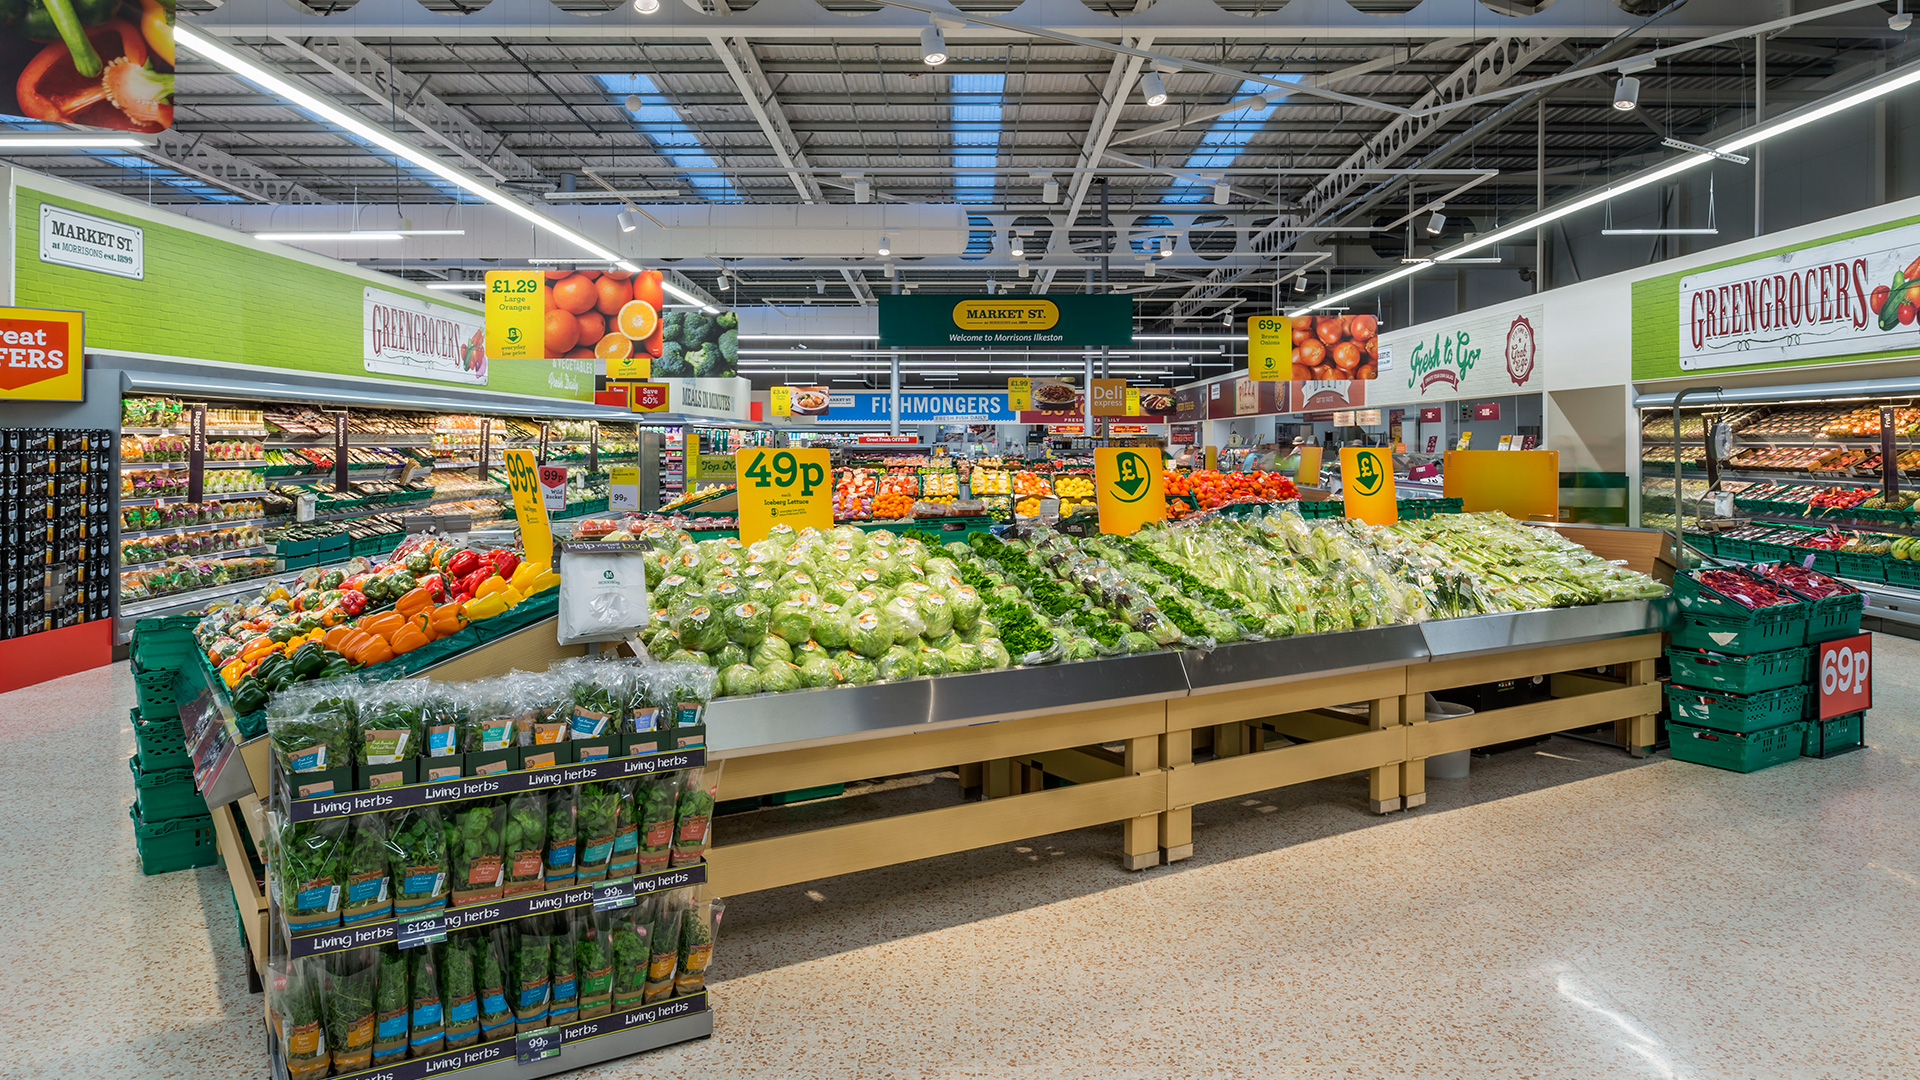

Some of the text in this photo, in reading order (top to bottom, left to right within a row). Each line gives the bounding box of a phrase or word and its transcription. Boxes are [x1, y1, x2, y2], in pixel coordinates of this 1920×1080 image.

[52, 220, 134, 252] MARKET ST.
[52, 242, 60, 250] at
[62, 242, 103, 258] MORRISONS
[104, 252, 116, 262] est.
[492, 280, 537, 293] £1.29
[1690, 258, 1868, 351] GREENGROCERS
[966, 309, 1046, 318] MARKET ST.
[1258, 320, 1282, 332] 69p
[372, 304, 460, 367] GREENGROCERS
[949, 334, 983, 342] Welcome
[994, 334, 1032, 342] Morrisons
[1034, 333, 1064, 342] Ilkeston
[1408, 333, 1441, 388] Fresh
[1444, 336, 1452, 364] to
[642, 396, 658, 404] 50%
[682, 387, 702, 408] MEALS
[702, 390, 708, 408] IN
[709, 392, 730, 411] MINUTES
[1094, 386, 1122, 400] Deli
[1094, 400, 1122, 408] express
[194, 411, 202, 434] Bagged
[702, 460, 720, 472] Top
[744, 451, 824, 496] 49p
[507, 452, 538, 504] 99p
[544, 470, 564, 482] 99p
[614, 494, 628, 502] 99p
[567, 542, 595, 550] Help
[622, 542, 648, 551] bag
[1822, 646, 1869, 695] 69p
[624, 755, 688, 772] Living herbs
[529, 767, 597, 785] Living herbs
[425, 780, 499, 799] Living herbs
[313, 795, 393, 815] Living herbs
[634, 873, 688, 891] ving herbs
[604, 886, 622, 898] 99p
[529, 896, 562, 910] Living
[464, 908, 500, 922] herbs
[314, 928, 394, 950] Living herbs
[625, 1002, 689, 1025] Living herbs
[565, 1024, 598, 1039] herbs
[529, 1036, 548, 1048] 99p
[426, 1048, 500, 1073] Living herbs
